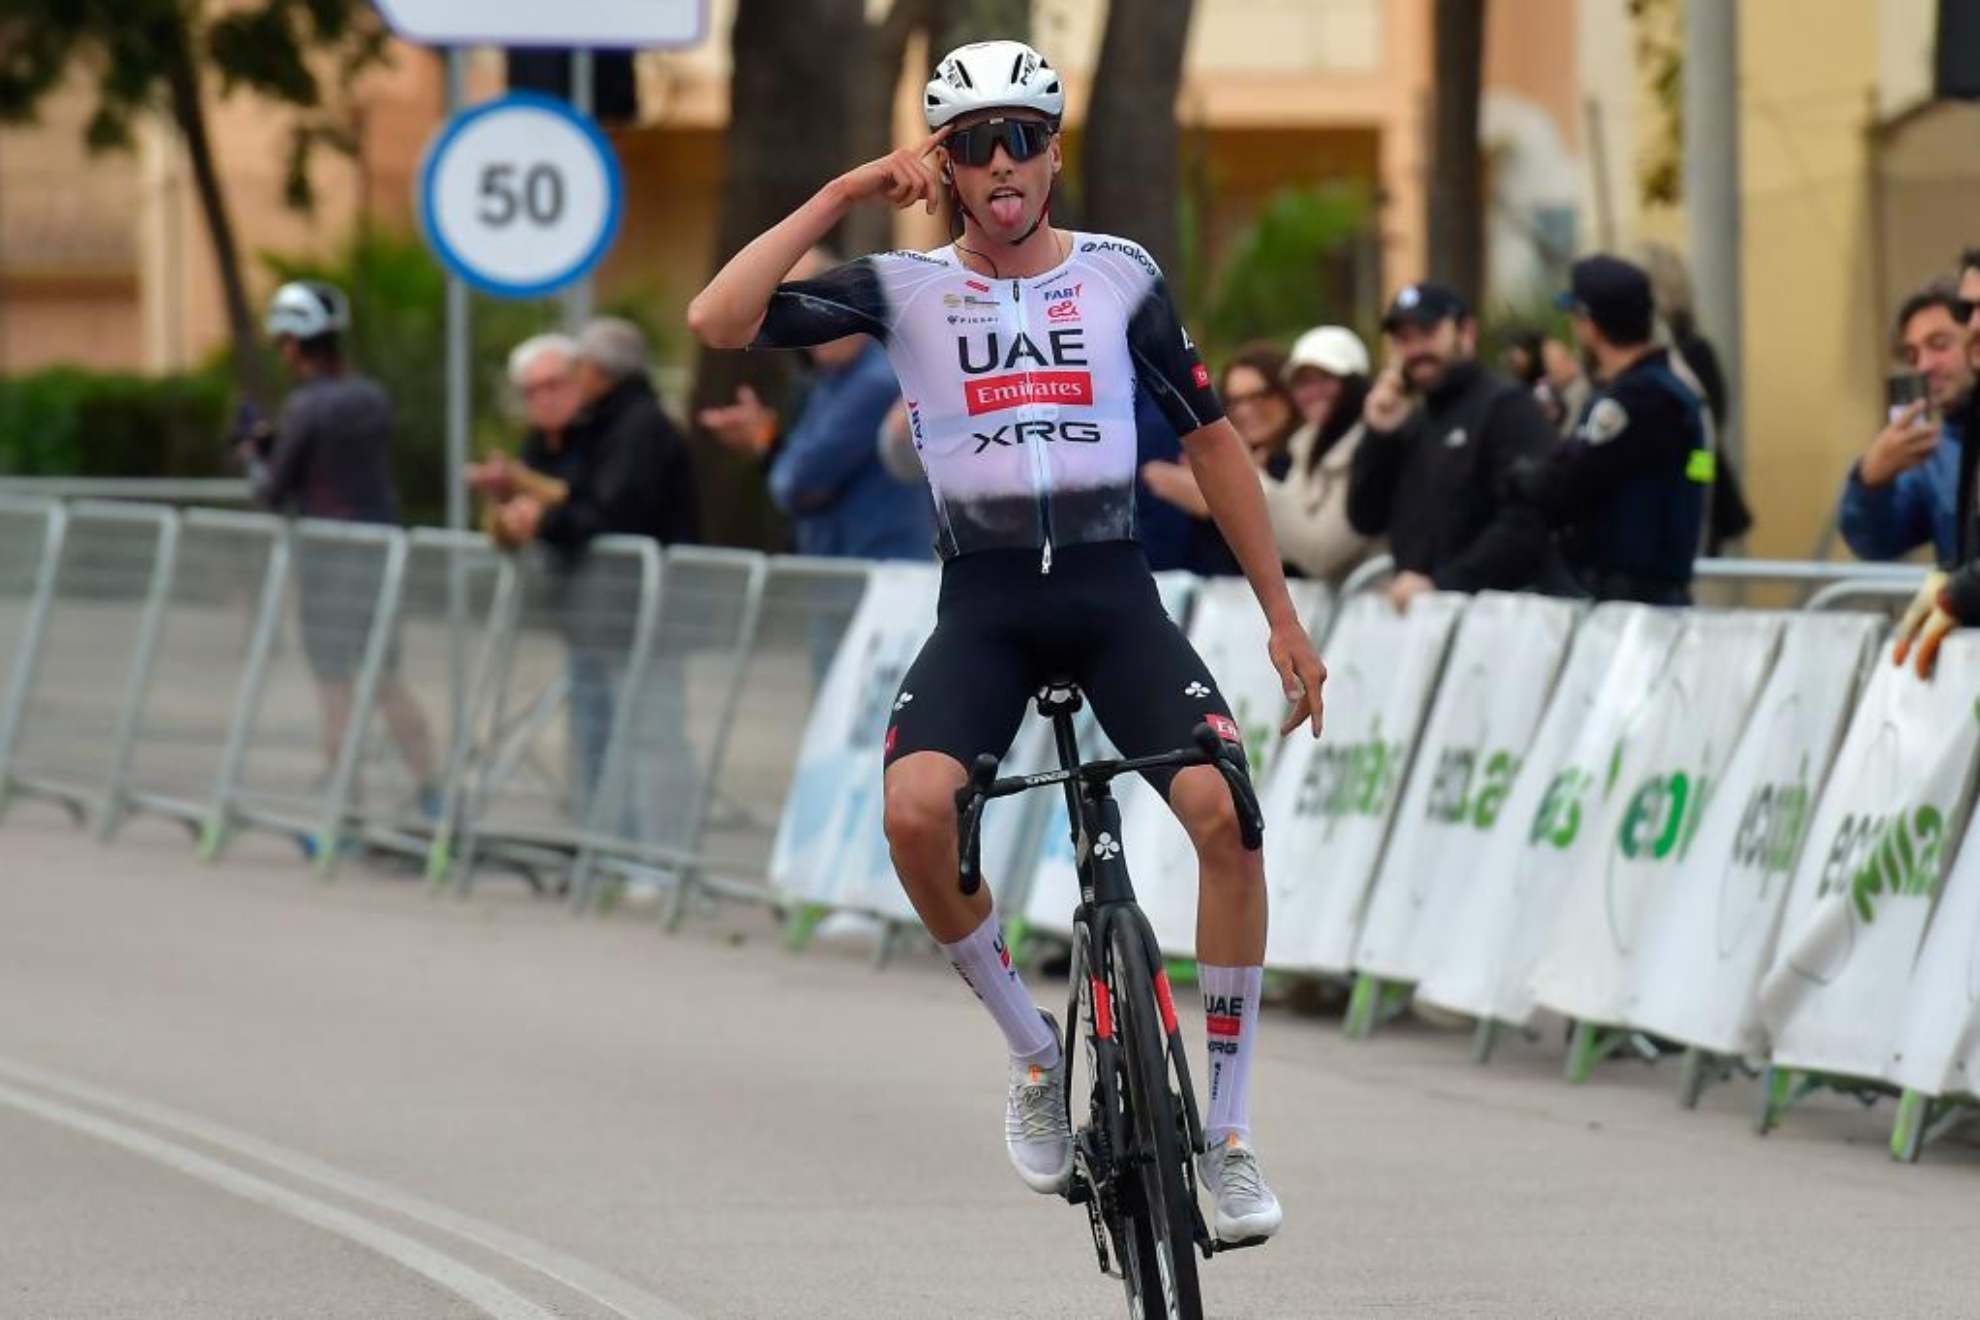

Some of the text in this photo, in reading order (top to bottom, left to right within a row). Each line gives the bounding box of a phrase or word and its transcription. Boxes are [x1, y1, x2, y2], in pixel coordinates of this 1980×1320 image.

[479, 163, 565, 226] 50
[1098, 241, 1157, 276] Analog
[958, 328, 1088, 375] UAE
[976, 381, 1082, 404] Emirates
[972, 420, 1102, 454] XRG
[1204, 994, 1243, 1017] UAE
